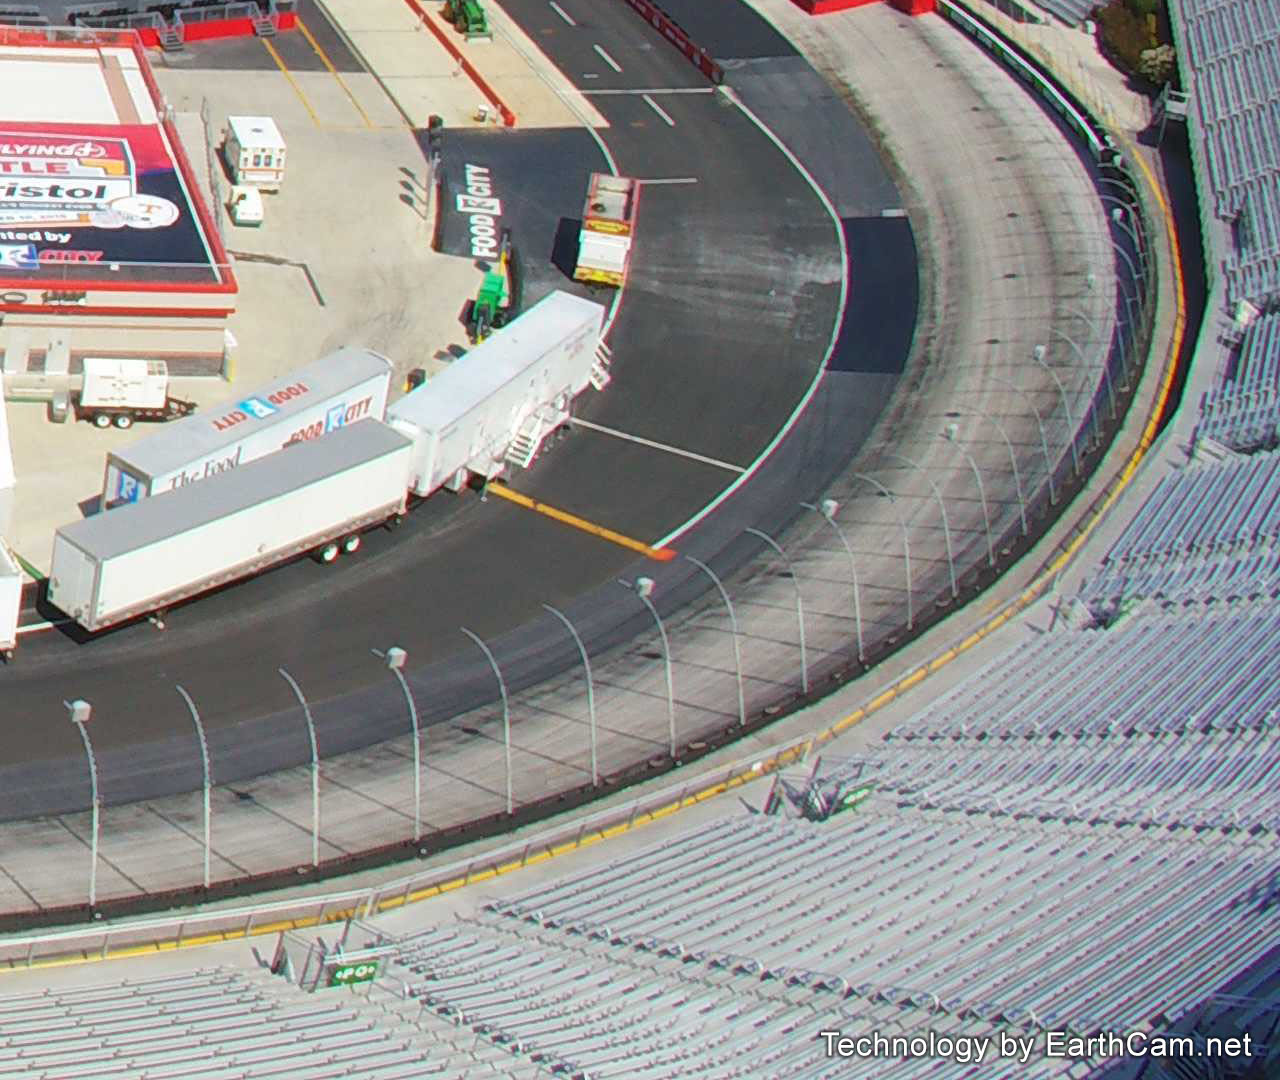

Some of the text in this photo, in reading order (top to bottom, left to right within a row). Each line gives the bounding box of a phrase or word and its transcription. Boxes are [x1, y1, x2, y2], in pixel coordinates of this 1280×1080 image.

[464, 163, 498, 259] FOOD CITY
[44, 231, 72, 244] by
[38, 249, 105, 263] CITY
[212, 382, 310, 432] FOOD CITY
[344, 396, 373, 423] CITY
[168, 473, 200, 490] The
